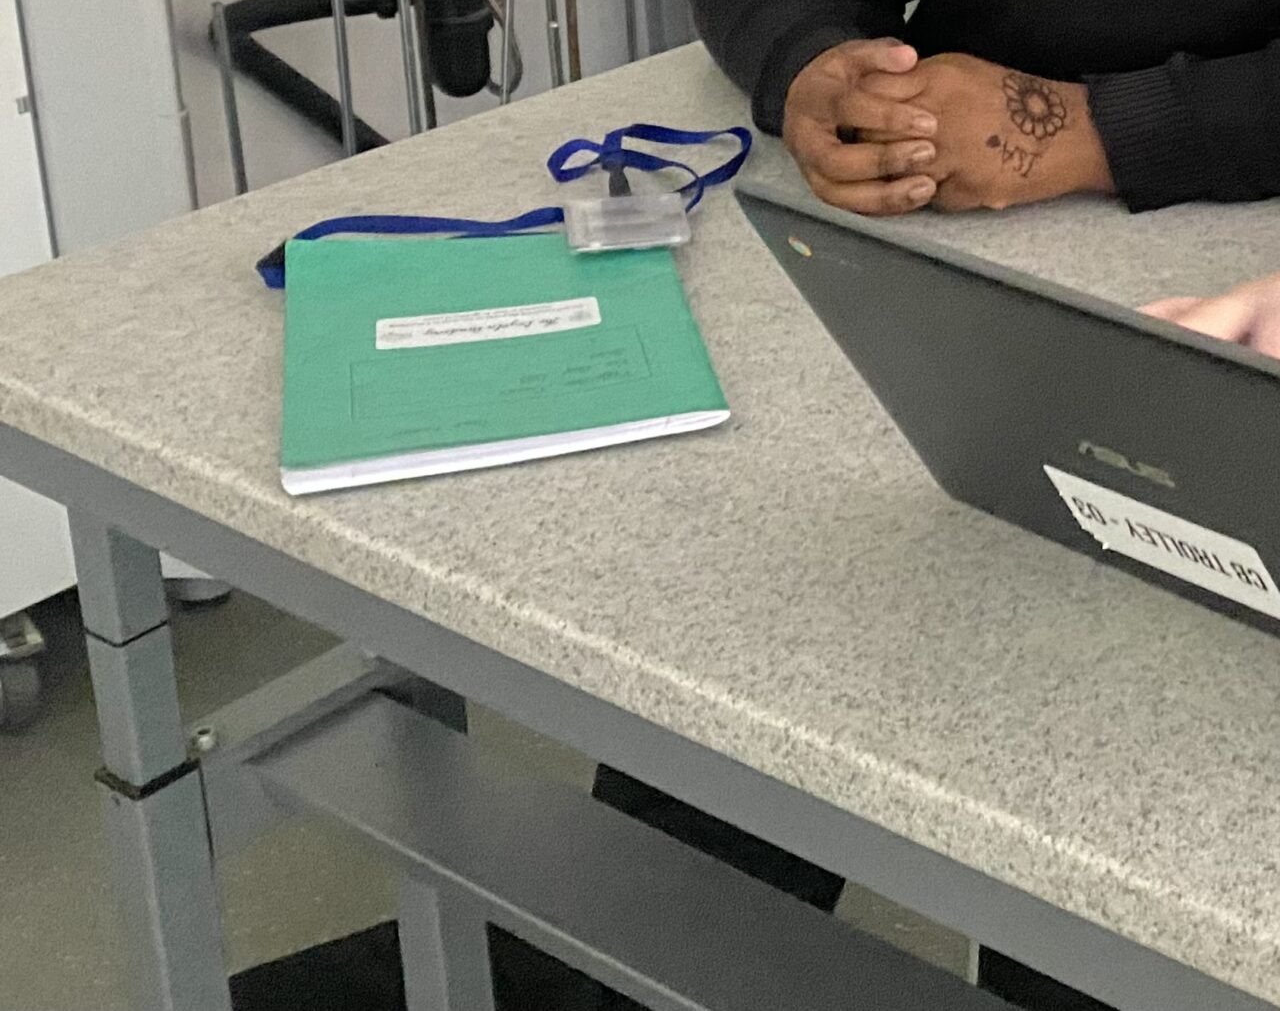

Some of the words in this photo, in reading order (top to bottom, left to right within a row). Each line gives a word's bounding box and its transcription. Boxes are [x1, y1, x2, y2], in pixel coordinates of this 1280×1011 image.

[1072, 496, 1107, 526] 03
[1125, 518, 1232, 578] TROLLEY
[1230, 561, 1269, 592] CB
